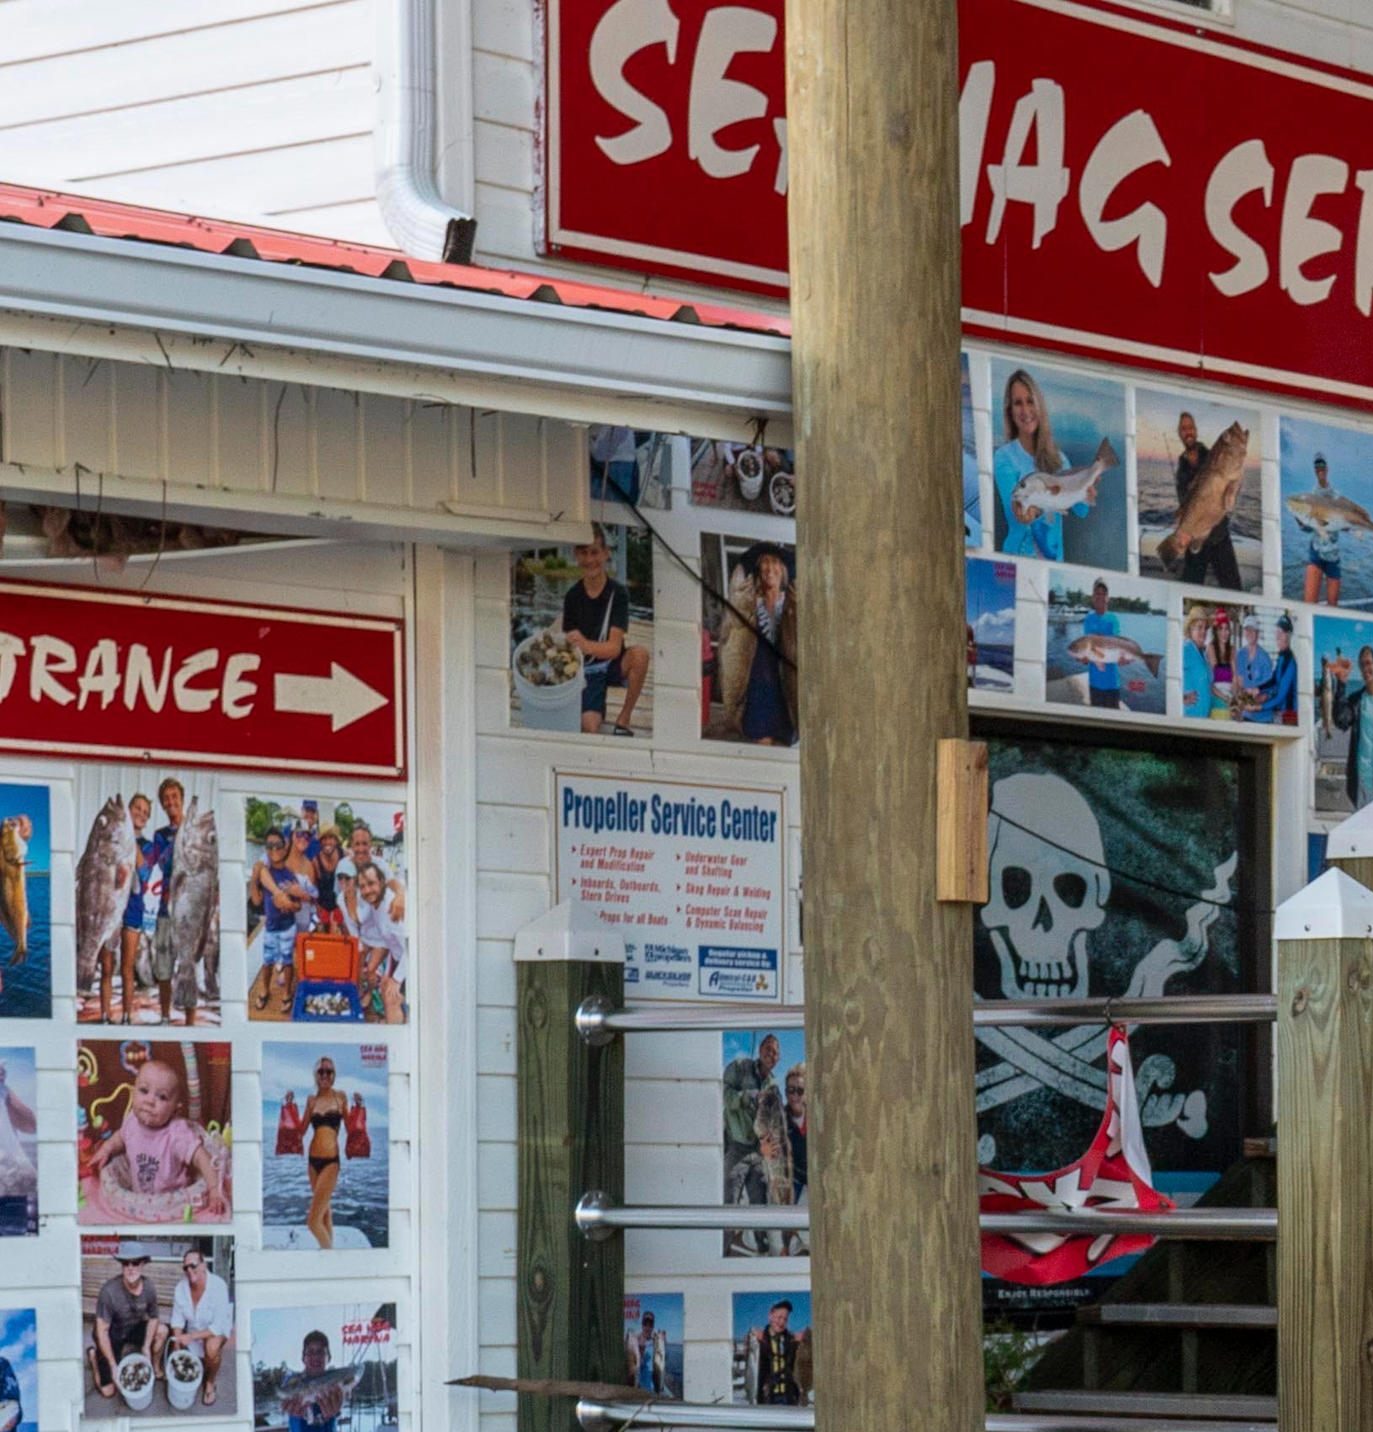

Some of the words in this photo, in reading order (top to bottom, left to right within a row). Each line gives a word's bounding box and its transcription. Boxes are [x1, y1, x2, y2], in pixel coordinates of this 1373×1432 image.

[589, 0, 788, 197] SE
[563, 786, 648, 834] Propeller
[650, 793, 717, 840] Service
[720, 800, 778, 843] Center
[580, 844, 607, 859] Expert
[609, 846, 628, 859] Prop
[630, 848, 656, 861] Repair
[685, 851, 728, 865] Underwater
[730, 854, 748, 867] Gear
[580, 859, 595, 869] and
[597, 858, 646, 873] Modification
[685, 865, 699, 876] and
[701, 865, 733, 880] Shafting
[581, 890, 603, 901] Stern
[604, 892, 631, 904] Drives
[706, 884, 731, 898] Repair
[733, 885, 740, 897] &
[742, 887, 772, 901] Welding
[623, 911, 635, 925] for
[637, 912, 646, 925] all
[648, 912, 669, 926] Boats
[685, 903, 722, 918] Computer
[724, 905, 743, 917] Scan
[744, 907, 769, 921] Repair
[686, 917, 692, 929] &
[694, 917, 726, 930] Dynamic
[729, 919, 765, 934] Balancing
